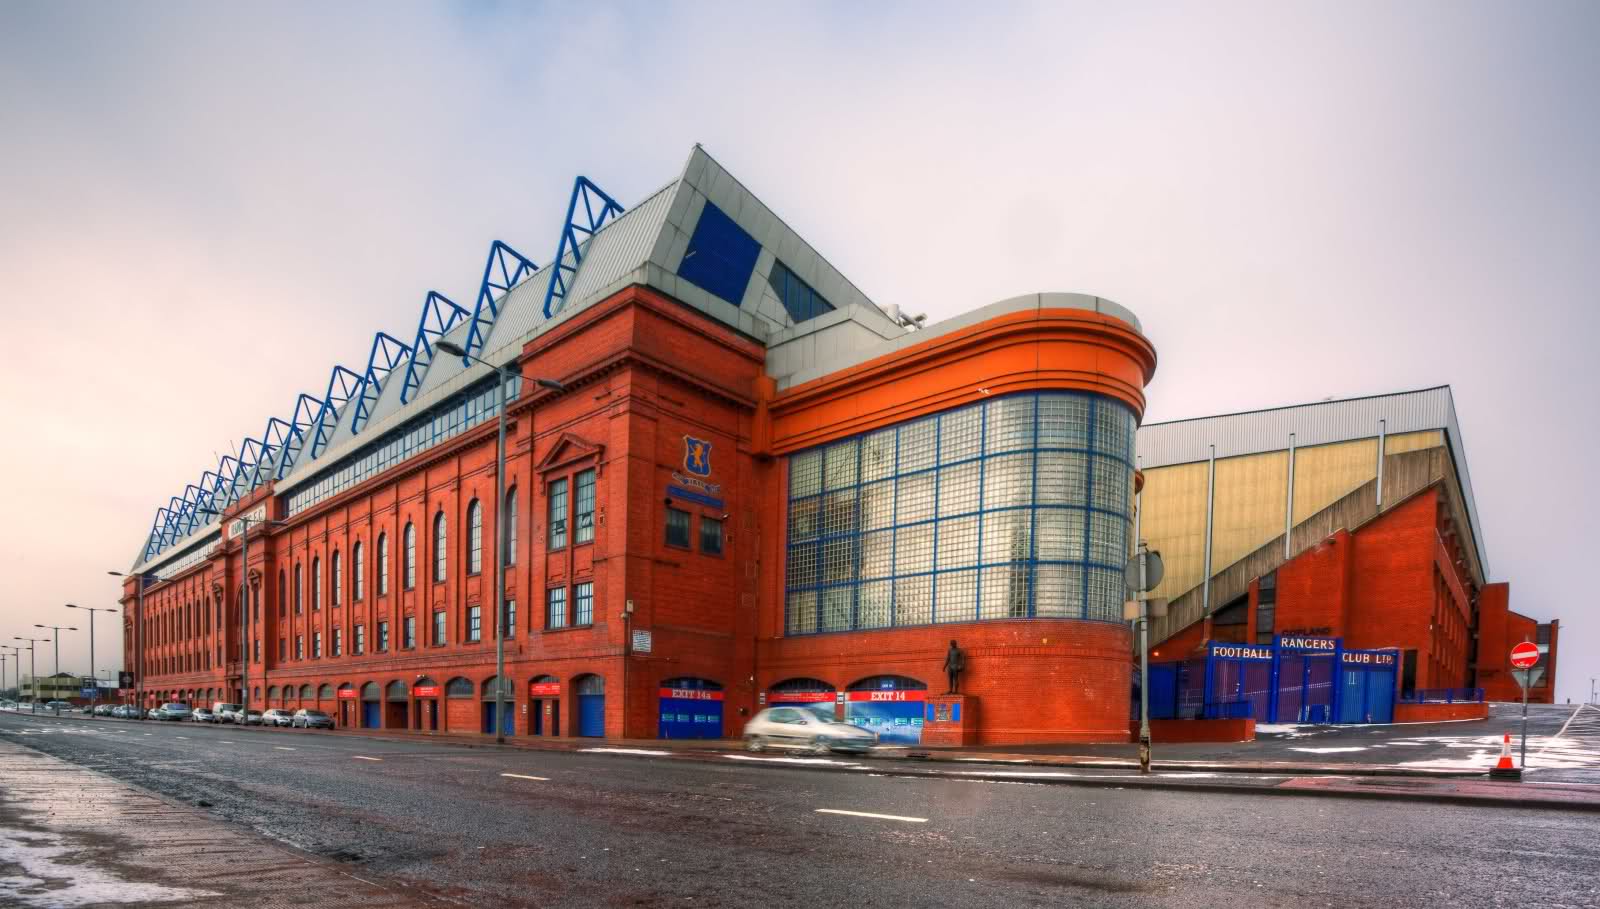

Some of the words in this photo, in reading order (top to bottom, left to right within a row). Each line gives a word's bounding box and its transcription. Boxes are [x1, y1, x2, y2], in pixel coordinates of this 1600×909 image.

[1281, 637, 1335, 650] RANGERS
[1213, 646, 1272, 659] FOOTBALL
[1342, 652, 1370, 664] CLUB
[672, 689, 695, 699] EXIT
[871, 691, 894, 701] EXIT
[896, 691, 905, 701] 14
